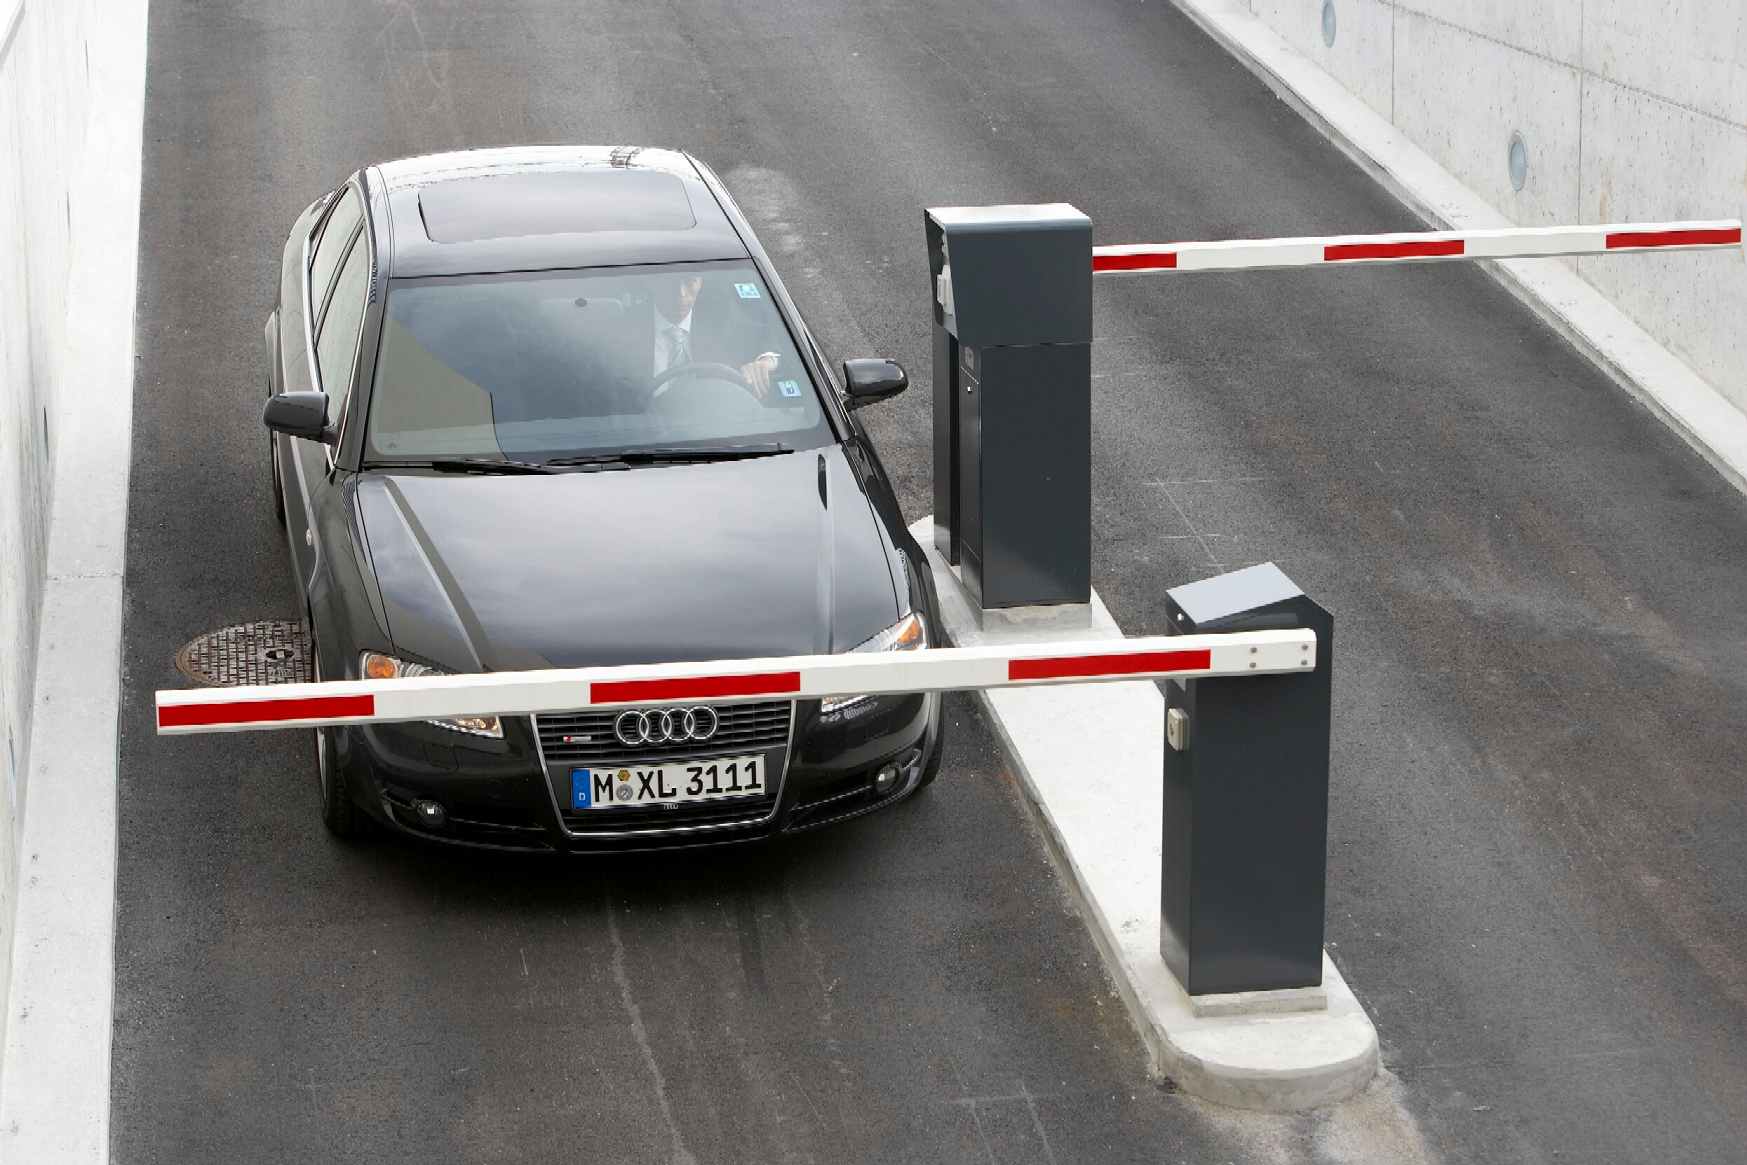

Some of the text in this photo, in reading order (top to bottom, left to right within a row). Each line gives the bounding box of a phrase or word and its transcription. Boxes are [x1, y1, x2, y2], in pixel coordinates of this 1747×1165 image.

[593, 760, 762, 802] M XL 3111
[578, 792, 586, 801] D
